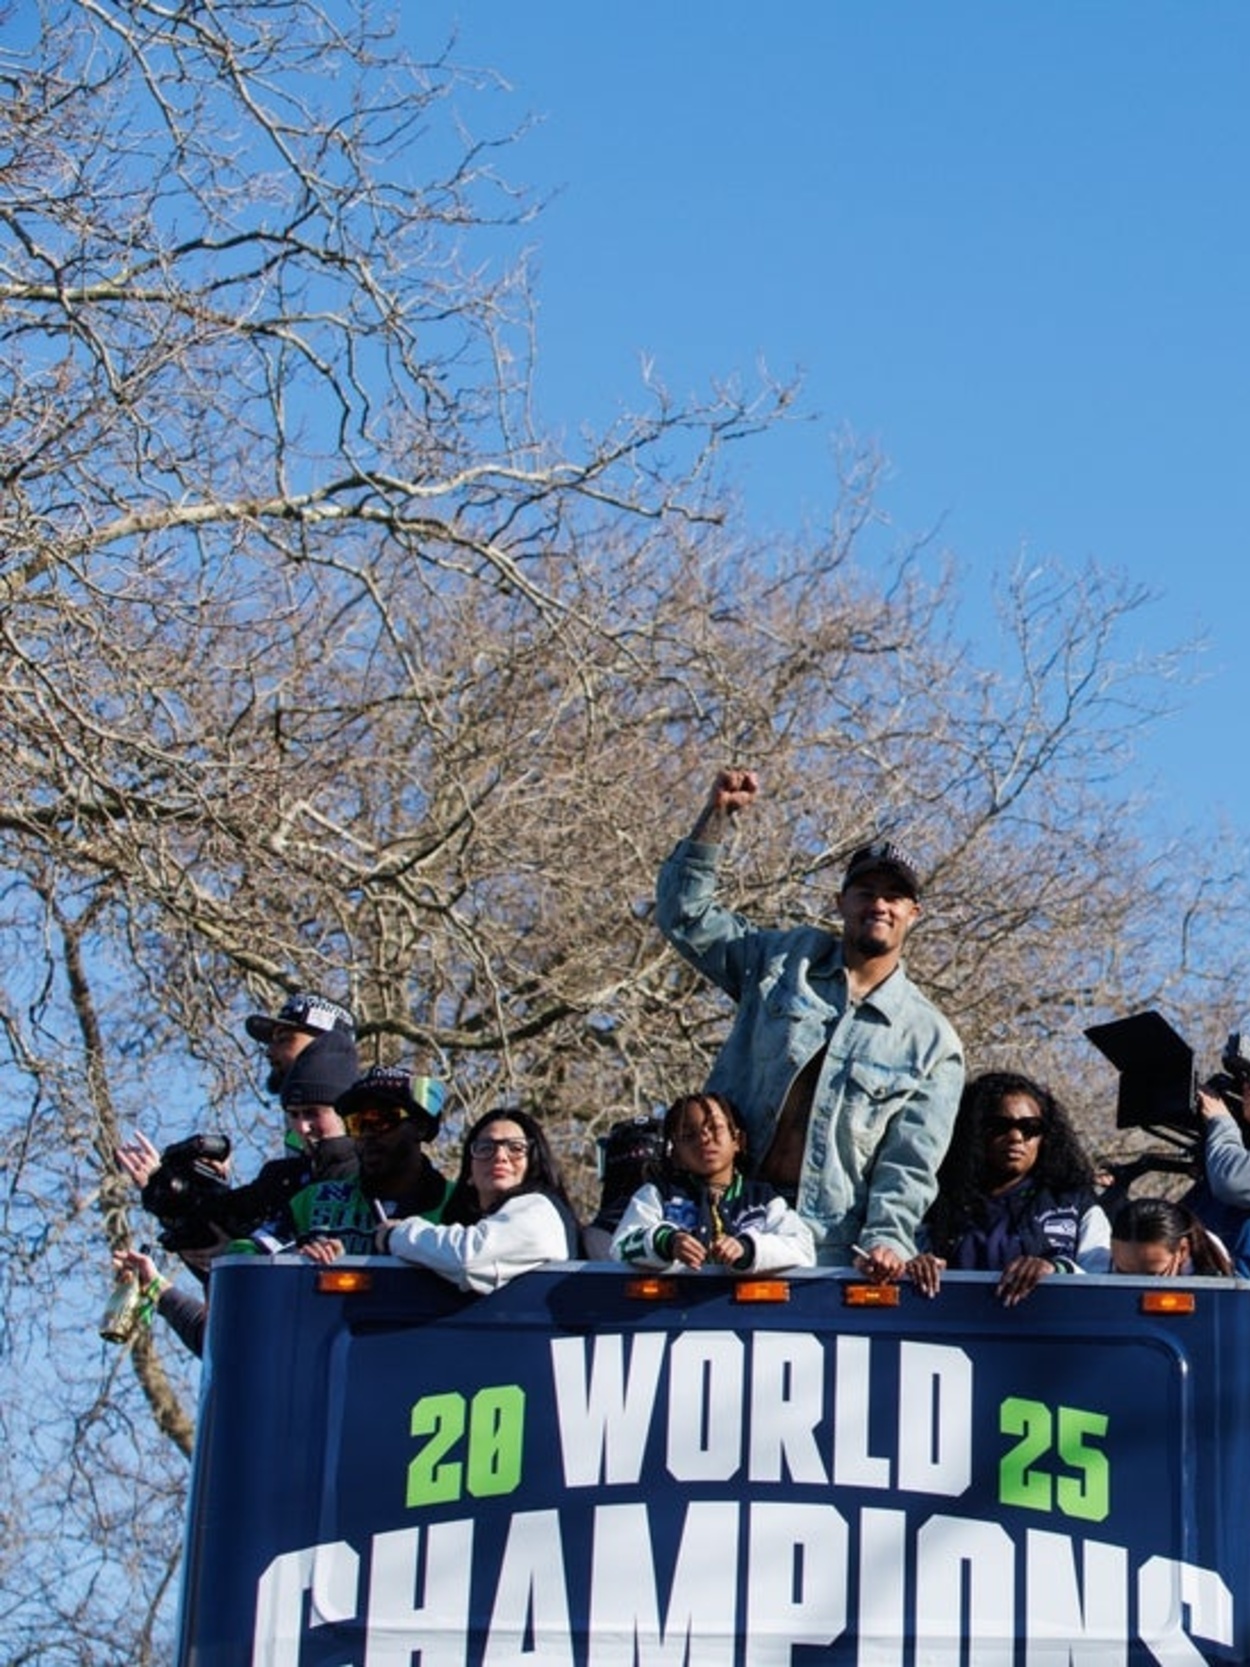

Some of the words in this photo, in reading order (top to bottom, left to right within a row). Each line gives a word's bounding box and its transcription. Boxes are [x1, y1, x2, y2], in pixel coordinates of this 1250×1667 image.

[406, 1384, 526, 1507] 20
[550, 1329, 973, 1497] WORLD
[999, 1397, 1110, 1522] 25
[252, 1500, 1234, 1667] CHAMPIONS
